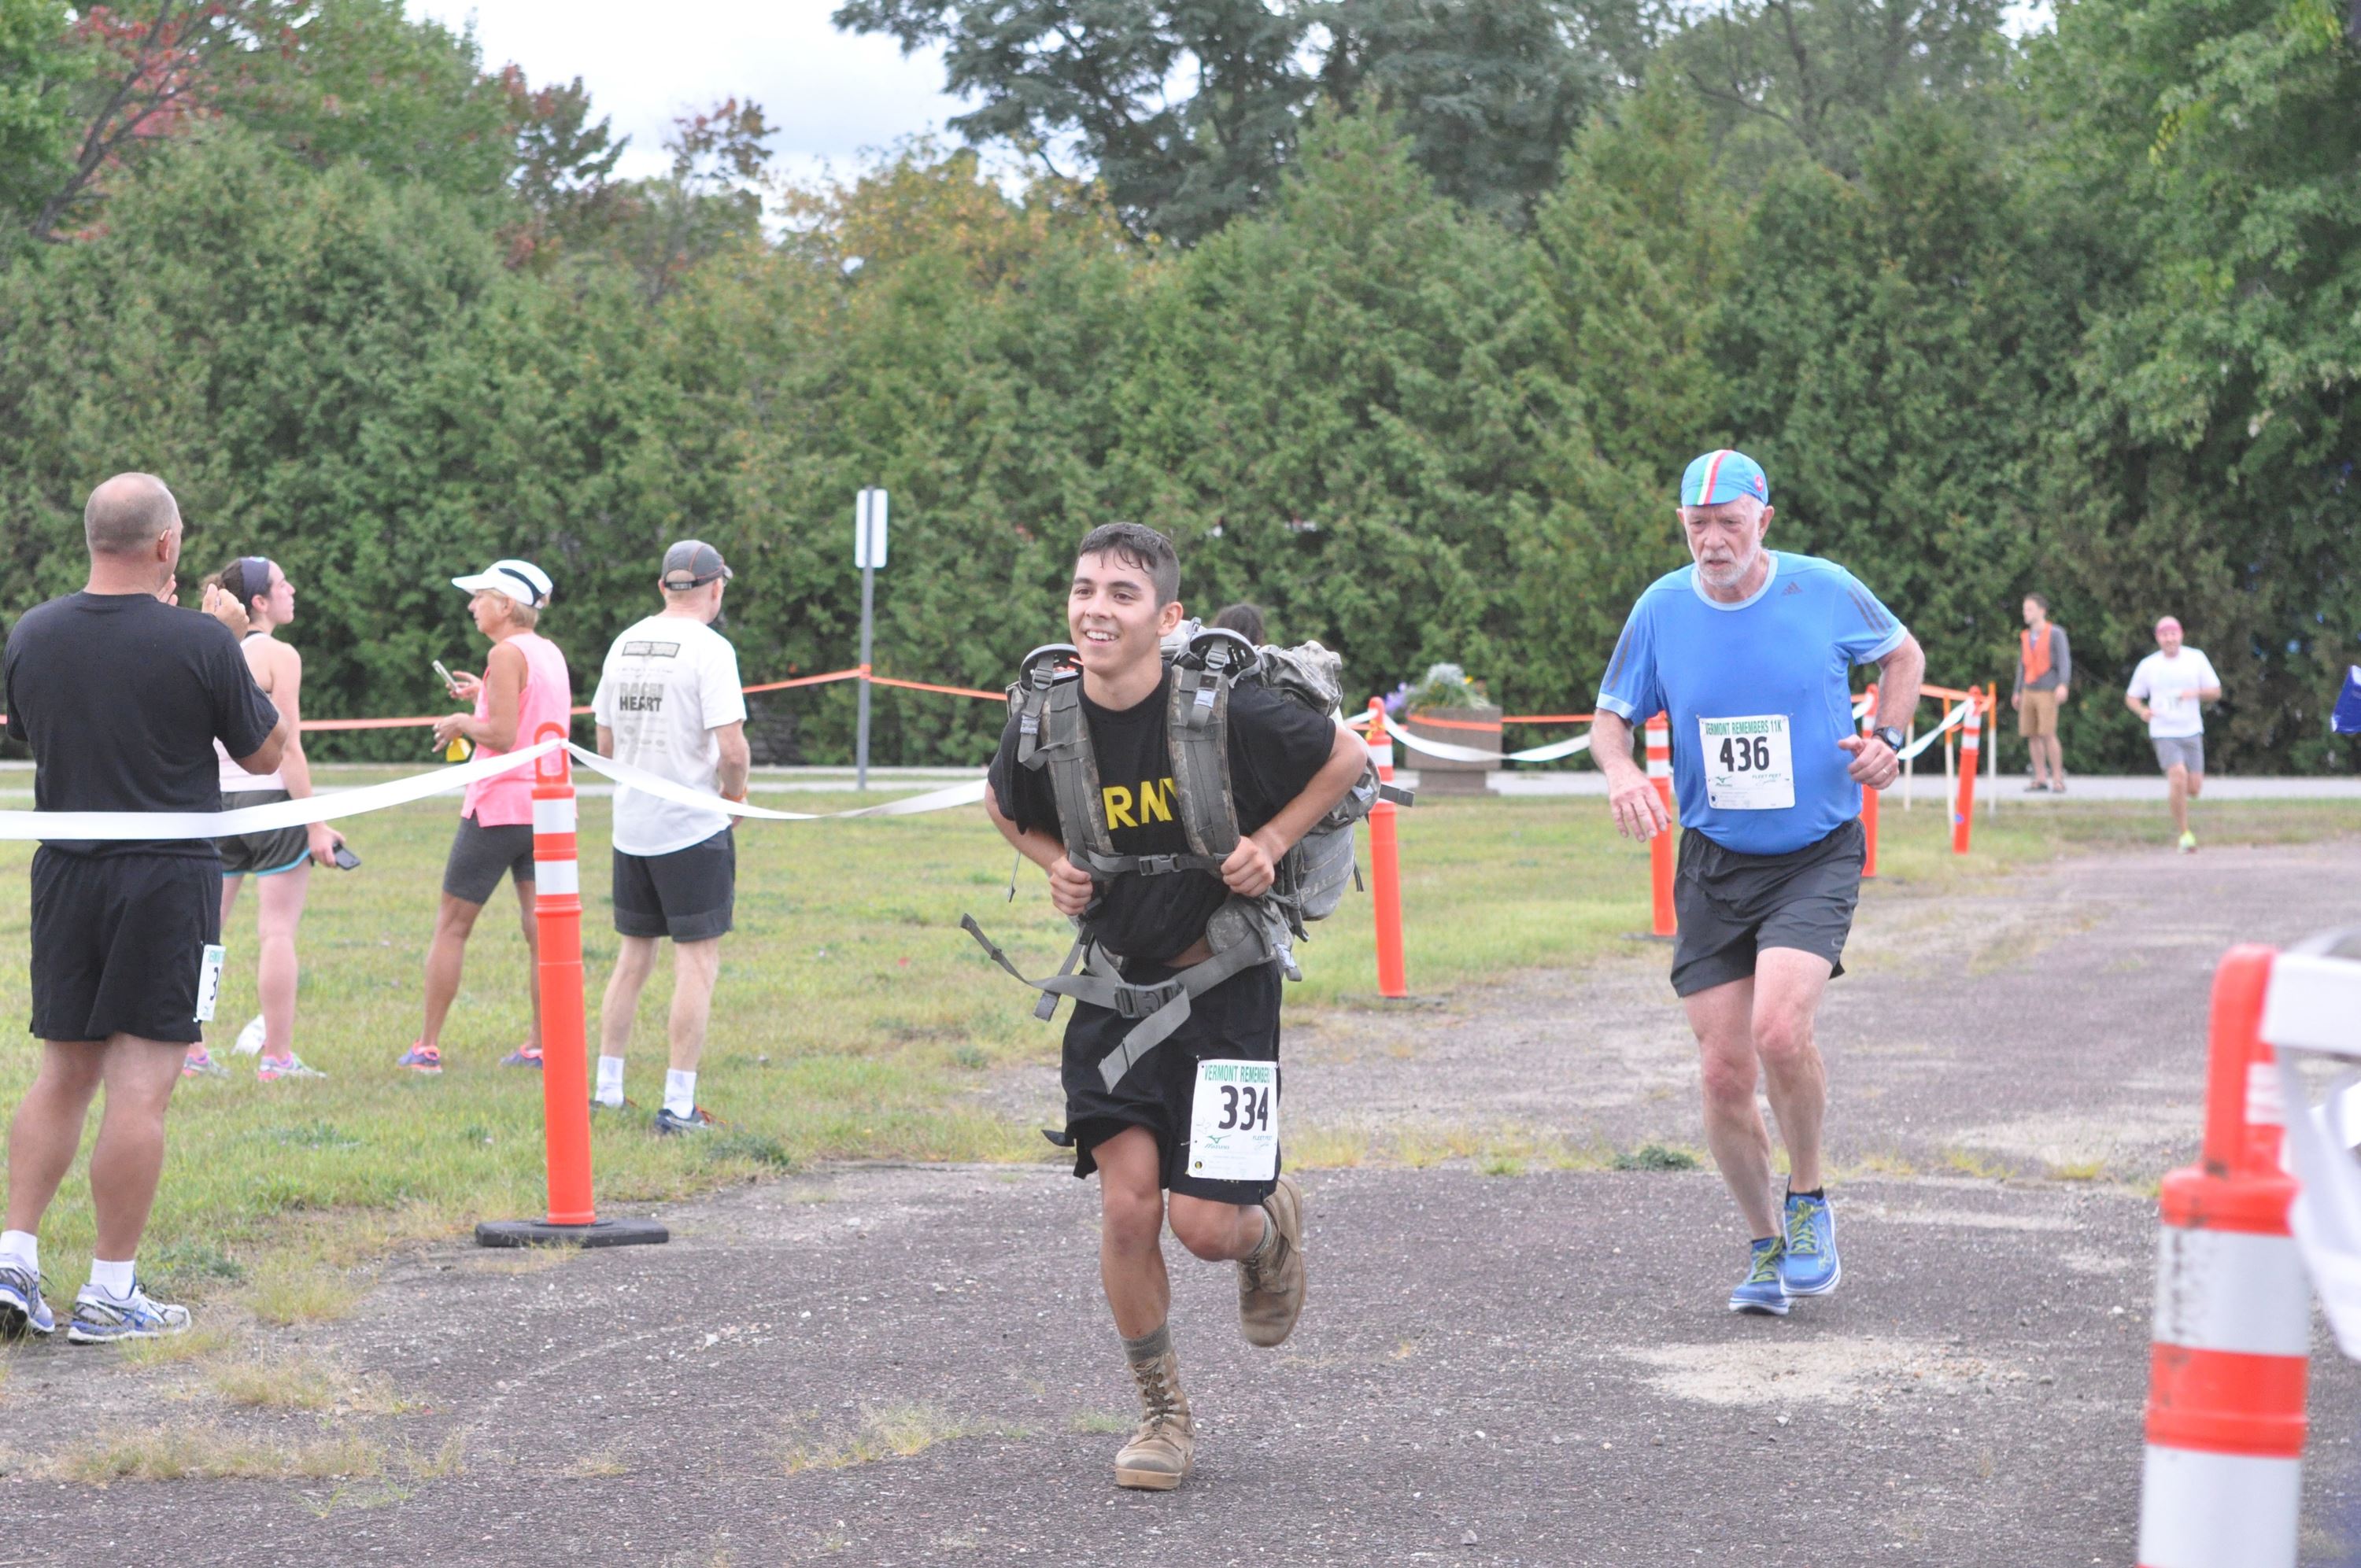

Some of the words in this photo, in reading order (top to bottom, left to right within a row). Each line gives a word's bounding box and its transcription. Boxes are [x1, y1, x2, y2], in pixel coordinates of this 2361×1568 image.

[619, 695, 663, 712] HEART
[1731, 720, 1769, 735] REMEMBERS
[1770, 719, 1783, 732] 11K
[1720, 736, 1770, 772] 436
[1204, 1064, 1239, 1083] VERMONT
[1217, 1085, 1269, 1131] 334
